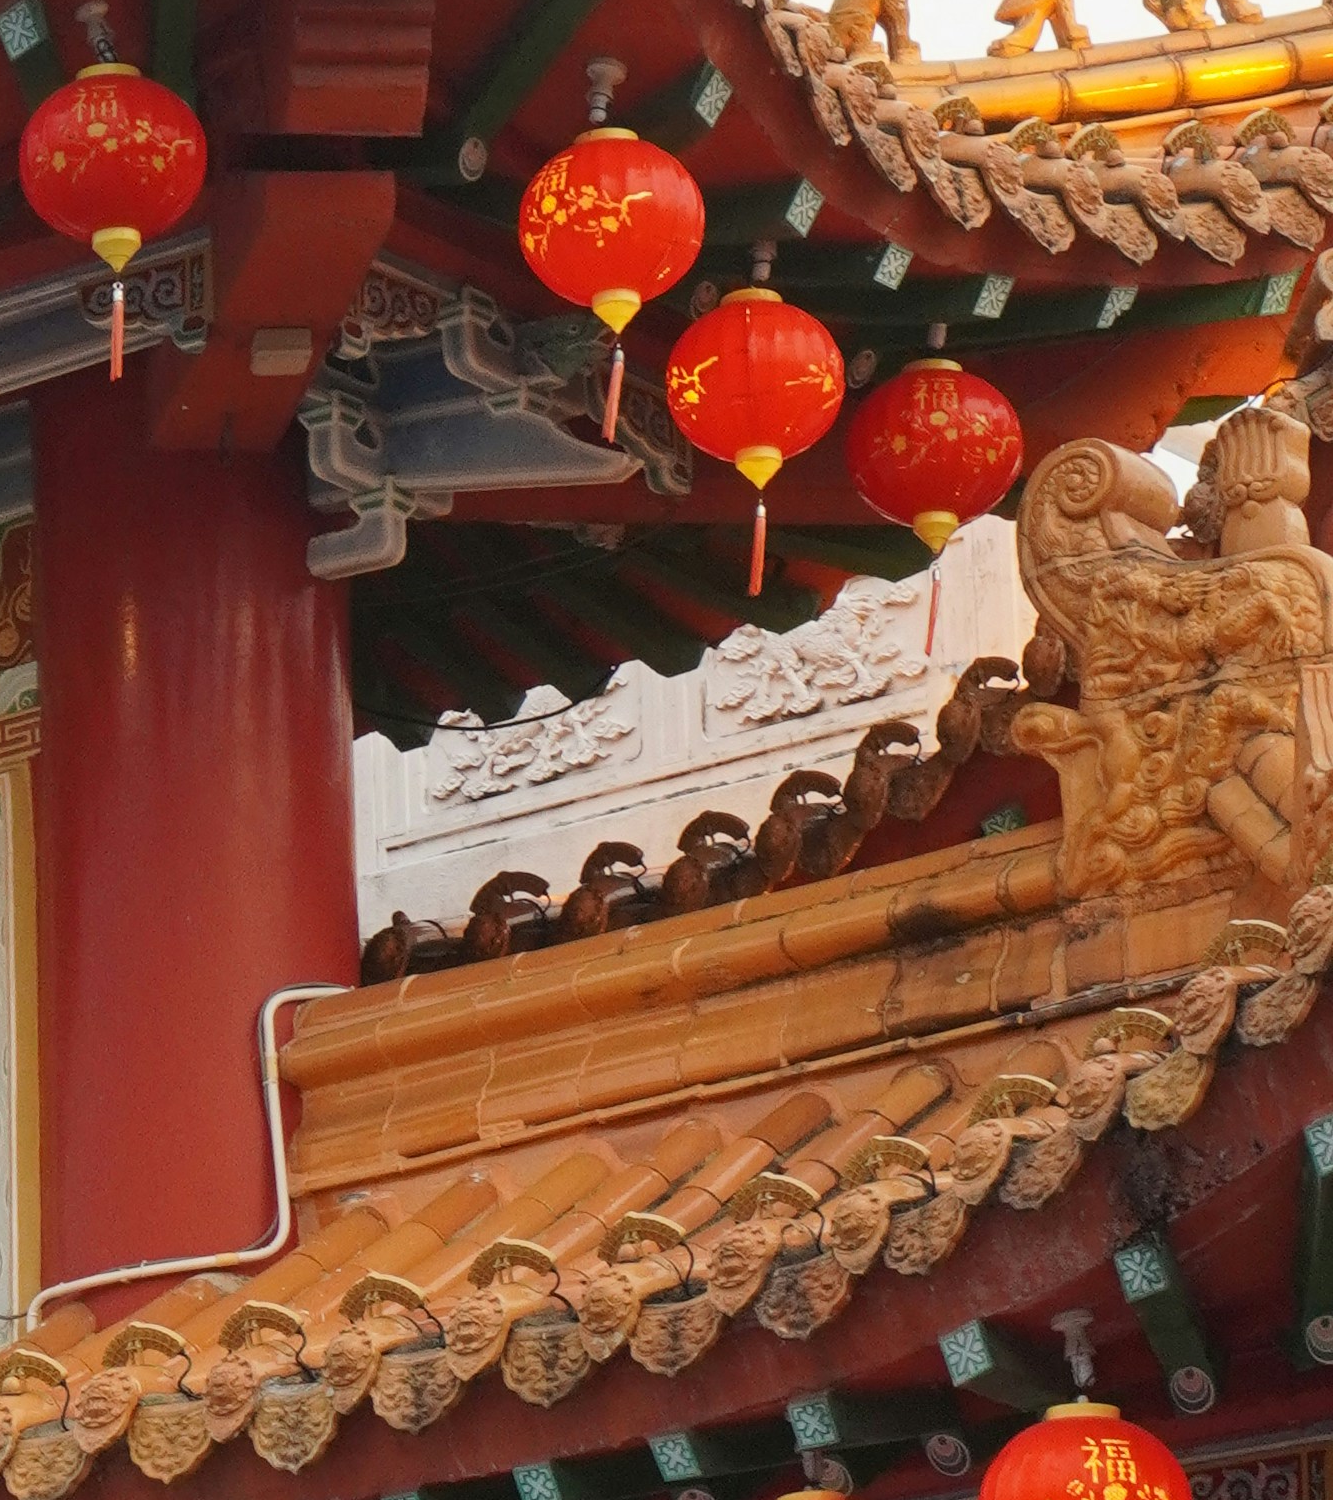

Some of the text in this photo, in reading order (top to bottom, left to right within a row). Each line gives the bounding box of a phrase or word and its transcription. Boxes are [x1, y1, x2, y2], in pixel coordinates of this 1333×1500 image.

[72, 85, 117, 122] 福
[531, 155, 574, 201] 福
[915, 379, 959, 417] 福
[1079, 1437, 1135, 1484] 福
